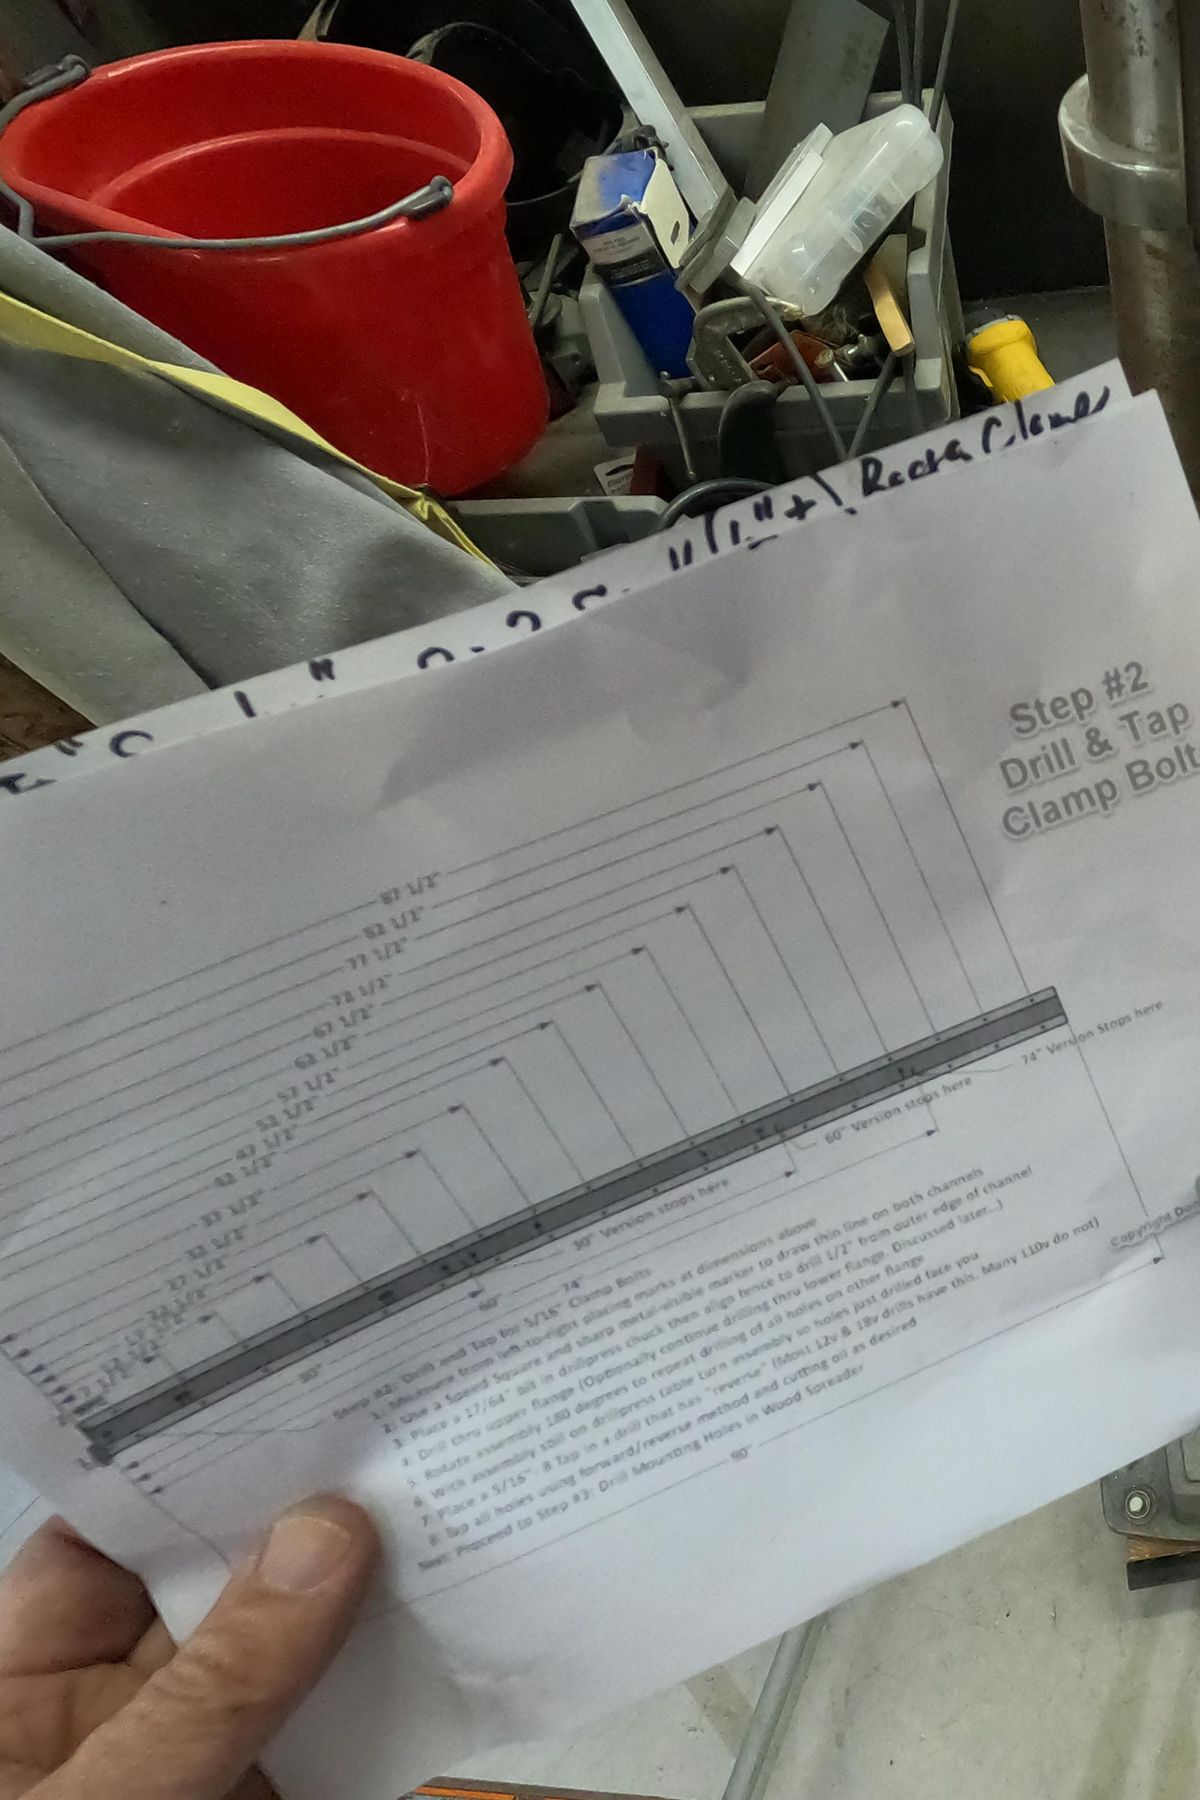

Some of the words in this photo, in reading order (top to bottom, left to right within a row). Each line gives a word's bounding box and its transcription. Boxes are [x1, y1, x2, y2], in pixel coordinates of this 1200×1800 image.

[998, 737, 1077, 789] Drill
[1080, 723, 1114, 758] &
[1117, 695, 1194, 749] Tap
[1007, 681, 1099, 740] Step
[1099, 659, 1149, 701] #2
[999, 776, 1121, 840] Clamp
[1045, 1026, 1095, 1056] Version
[1096, 1010, 1133, 1035] Stops
[1132, 997, 1165, 1019] here
[823, 1126, 848, 1145] 60"
[850, 1102, 902, 1134] Version
[903, 1086, 942, 1112] stops
[944, 1076, 973, 1097] here
[600, 1208, 655, 1240] Version
[657, 1192, 696, 1216] stops
[697, 1176, 730, 1197] here
[666, 1308, 700, 1330] then
[700, 1291, 737, 1317] align
[776, 1268, 792, 1282] to
[794, 1253, 823, 1274] drill
[824, 1239, 856, 1262] 1/2"
[857, 1225, 890, 1248] from
[892, 1209, 929, 1233] outer
[930, 1194, 964, 1219] edge
[964, 1186, 980, 1201] of
[980, 1163, 1033, 1195] channel
[706, 1264, 755, 1292] marker
[757, 1255, 774, 1270] to
[774, 1239, 810, 1262] draw
[812, 1225, 842, 1246] thin
[842, 1213, 869, 1233] line
[870, 1207, 889, 1222] on
[890, 1191, 924, 1213] both
[925, 1164, 984, 1199] channels
[1110, 1212, 1172, 1246] Copyright
[632, 1277, 676, 1303] marks
[694, 1233, 774, 1277] dimensions
[776, 1215, 818, 1241] above
[720, 1298, 771, 1330] drilling
[771, 1285, 801, 1306] thru
[802, 1267, 843, 1292] lower
[890, 1218, 956, 1254] Discussed
[769, 1342, 812, 1371] (Most
[813, 1331, 840, 1351] 12v
[841, 1325, 853, 1338] &
[854, 1312, 881, 1332] 18v
[879, 1297, 915, 1321] drills
[915, 1282, 949, 1304] have
[980, 1251, 1019, 1278] Many
[1021, 1238, 1050, 1259] 110v
[1050, 1228, 1070, 1246] do
[1070, 1215, 1101, 1238] not)
[649, 1352, 697, 1382] repeat
[697, 1329, 748, 1361] drilling
[747, 1321, 765, 1337] of
[785, 1296, 823, 1321] holes
[824, 1288, 844, 1304] on
[844, 1270, 883, 1295] other
[883, 1251, 927, 1281] flange
[697, 1360, 728, 1381] turn
[729, 1330, 793, 1368] assembly
[794, 1324, 811, 1338] so
[812, 1305, 850, 1330] holes
[851, 1293, 879, 1315] just
[879, 1274, 923, 1301] drilled
[923, 1260, 953, 1281] face
[954, 1250, 981, 1271] you
[694, 1392, 751, 1425] method
[751, 1378, 780, 1400] and
[779, 1355, 830, 1388] cutting
[829, 1346, 849, 1364] oil
[850, 1340, 867, 1355] as
[866, 1315, 918, 1347] desired
[702, 1419, 743, 1444] Holes
[759, 1389, 803, 1417] Wood
[804, 1361, 867, 1399] Spreader
